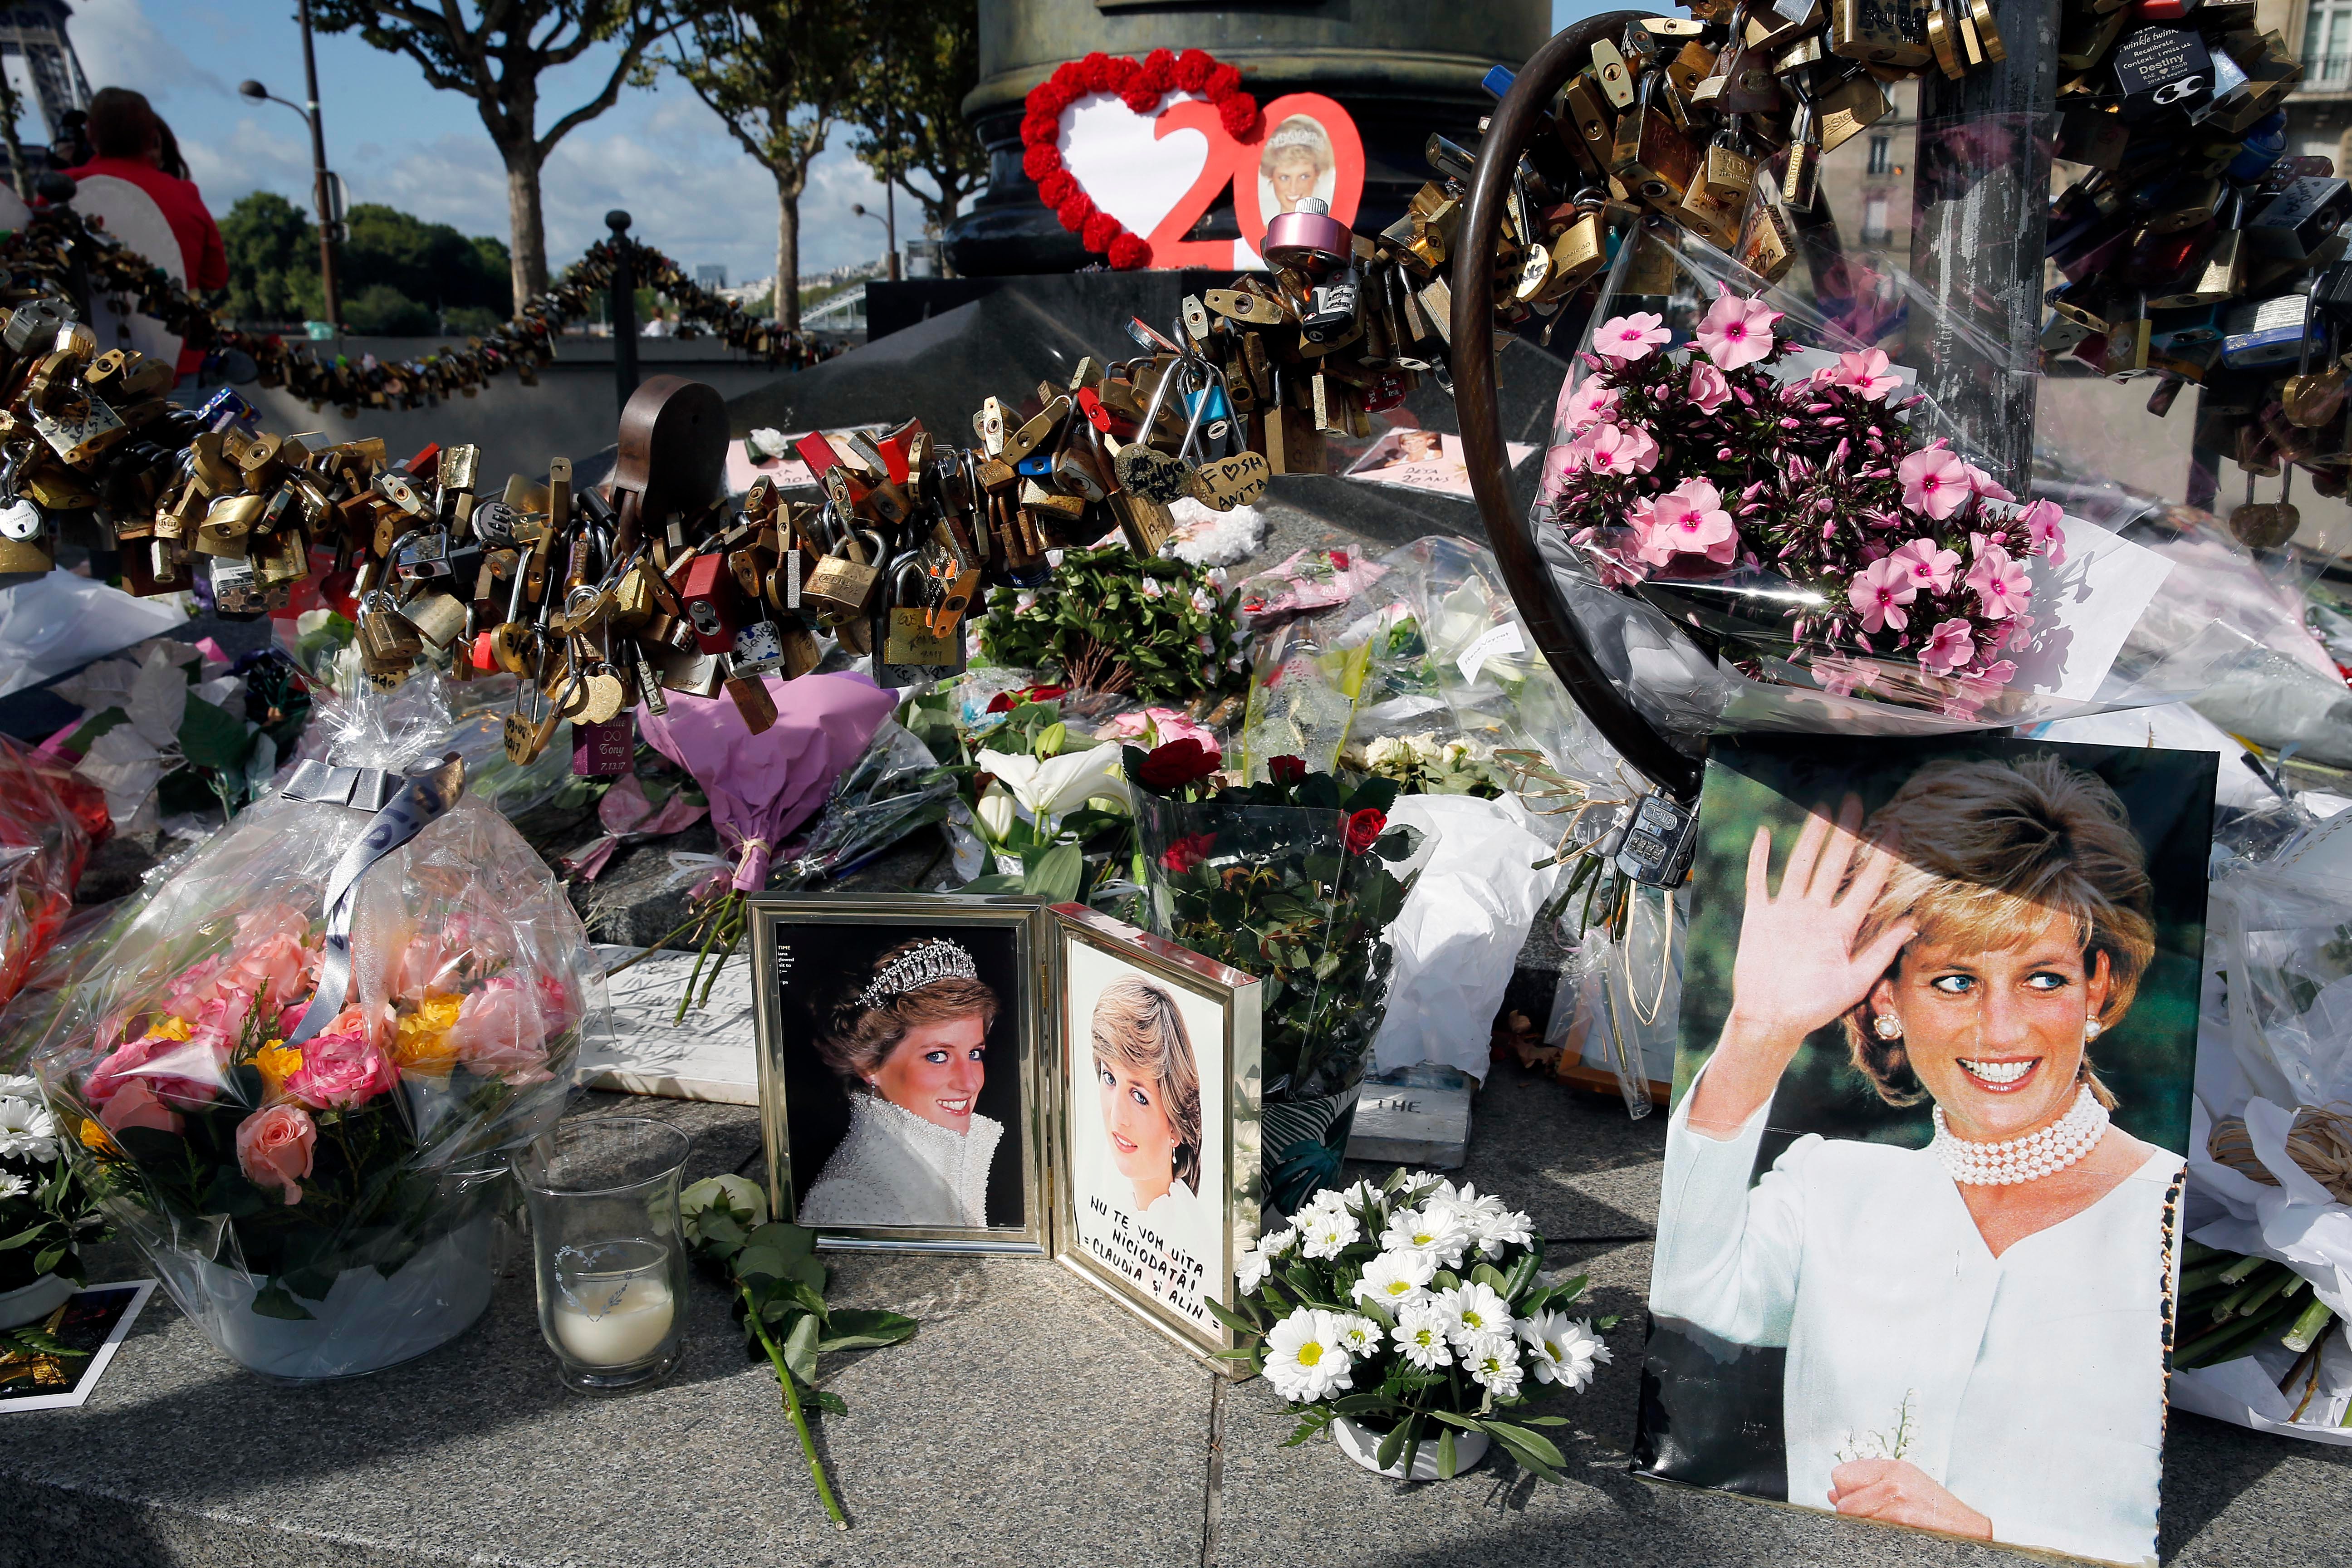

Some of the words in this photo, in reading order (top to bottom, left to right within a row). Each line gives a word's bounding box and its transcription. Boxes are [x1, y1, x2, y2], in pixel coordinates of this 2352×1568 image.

[2134, 39, 2176, 57] Recalibrate.
[2123, 55, 2155, 69] Context:
[2162, 46, 2180, 56] miss
[2138, 54, 2184, 75] Destiny
[2171, 61, 2188, 71] Zoob
[2167, 68, 2188, 78] beyond
[1154, 92, 1364, 270] 20
[599, 744, 624, 757] Tony
[600, 762, 626, 771] 7.13.17
[1371, 1097, 1421, 1113] THE
[1090, 1195, 1107, 1216] NU
[1114, 1210, 1129, 1229] TE
[1138, 1225, 1164, 1252] VOM
[1093, 1237, 1142, 1282] CLAUDiA
[1168, 1289, 1204, 1320] ALiN
